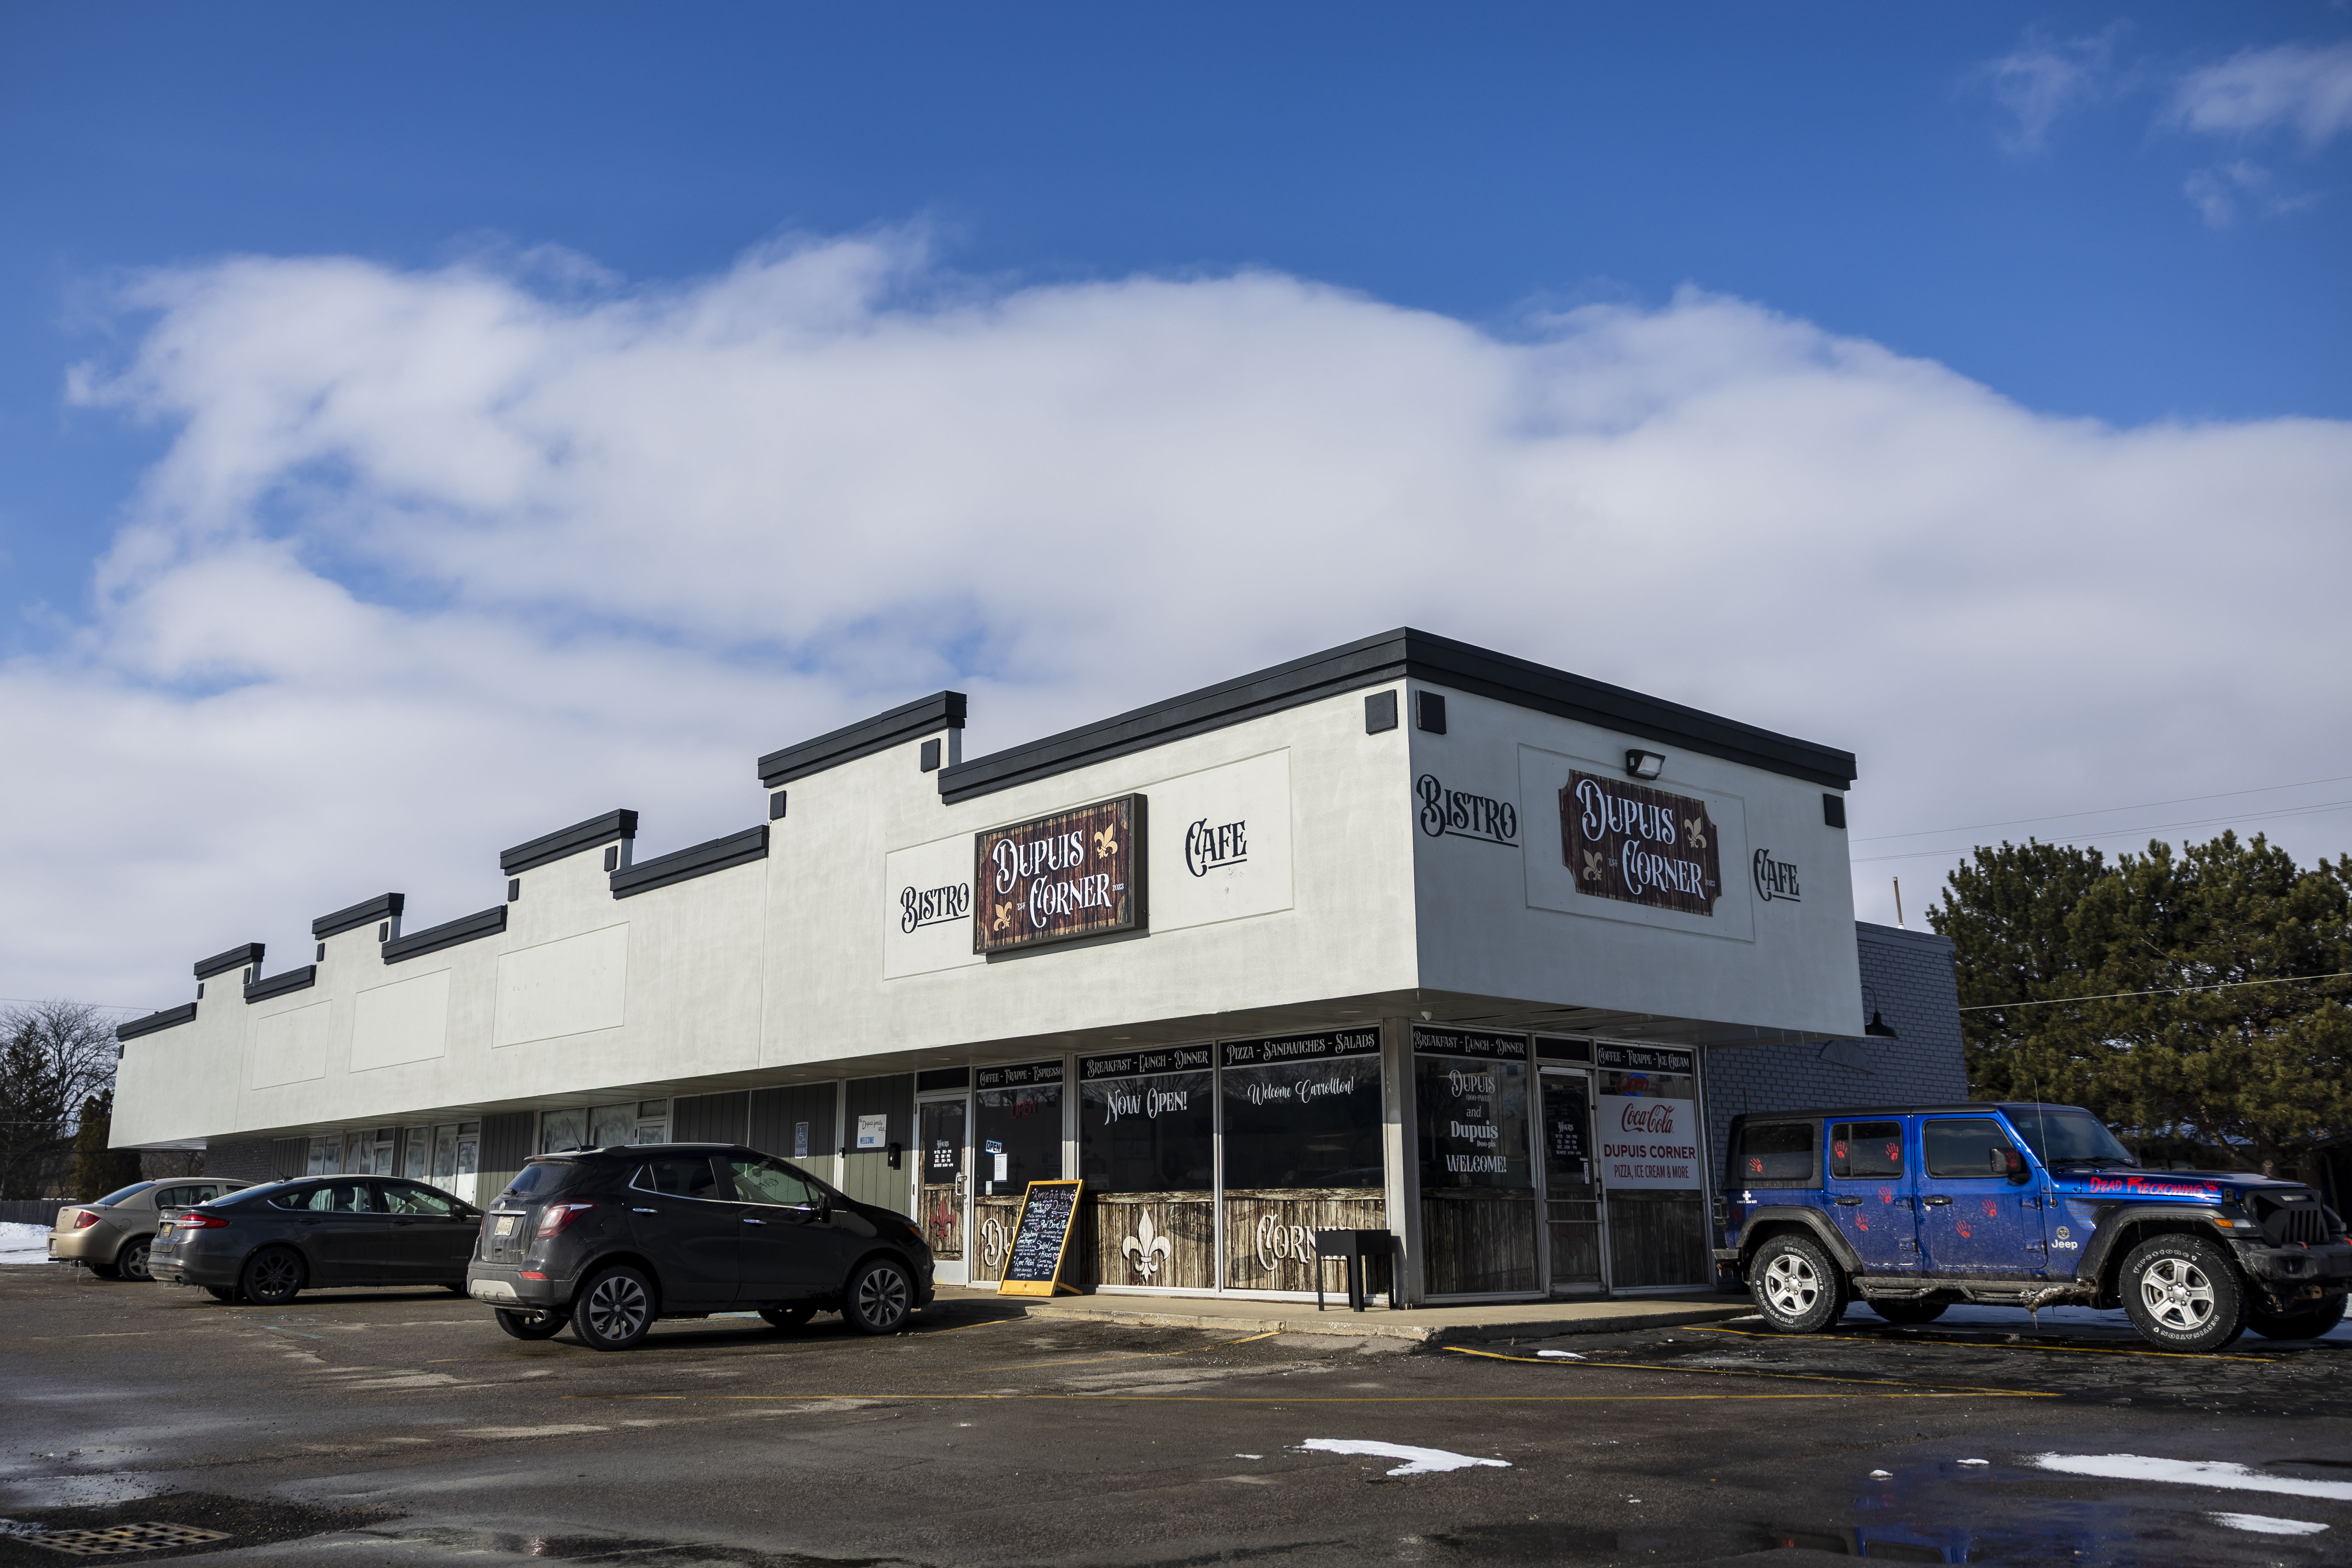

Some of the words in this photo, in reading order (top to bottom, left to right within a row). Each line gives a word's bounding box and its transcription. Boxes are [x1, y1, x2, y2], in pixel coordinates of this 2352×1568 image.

[1416, 774, 1517, 841] BISTRO
[1575, 779, 1675, 845] DUPUIS
[1185, 818, 1247, 877] CAFE
[992, 830, 1084, 895] DUPUIS
[1608, 858, 1618, 867] EST
[1622, 840, 1705, 900] CORNER
[1705, 879, 1715, 887] 2023
[1753, 848, 1799, 902] CAFE
[900, 882, 970, 933] BISTRO
[1017, 902, 1026, 911] EST
[1029, 873, 1112, 929] CORNER
[1112, 882, 1125, 892] 2023
[1227, 1045, 1254, 1065] PIZZA
[1264, 1038, 1325, 1060] SANDWICHES
[1335, 1034, 1375, 1054] SALADS
[1414, 1031, 1458, 1049] BREAKFAST
[1465, 1036, 1489, 1052] LUNCH
[1496, 1038, 1524, 1055] DINNER
[1087, 1058, 1131, 1078] BREAKFAST
[1139, 1054, 1166, 1072] LUNCH
[1174, 1050, 1208, 1069] DINNER
[1598, 1048, 1621, 1064] COFFEE
[1627, 1049, 1652, 1066] FRAPPE
[1656, 1052, 1667, 1068] ICE
[1668, 1054, 1689, 1069] CREAM
[980, 1071, 999, 1086] COFFEE
[1004, 1069, 1027, 1084] FRAPPE
[1033, 1066, 1063, 1080] ESPRESSO
[1449, 1070, 1495, 1097] DUPUIS
[1619, 1076, 1649, 1093] Open
[1248, 1082, 1291, 1105] Welcome
[1296, 1076, 1354, 1103] Carrollton!
[1012, 1098, 1036, 1119] OPEN
[1105, 1089, 1140, 1125] NOW
[1147, 1088, 1187, 1118] OPEN!
[1466, 1107, 1481, 1117] and
[874, 1120, 883, 1128] family
[1622, 1103, 1675, 1134] Coca-Cola
[1451, 1120, 1498, 1142] Dupuis
[987, 1142, 1001, 1152] OPEN
[1477, 1140, 1496, 1149] Doo-pis
[1604, 1144, 1646, 1158] DUPUIS
[1650, 1146, 1696, 1159] CORNER
[1446, 1155, 1507, 1173] WELCOME!
[1614, 1165, 1633, 1179] PIZZA,
[1634, 1165, 1644, 1178] ICE
[1645, 1165, 1666, 1178] CREAM
[1667, 1166, 1671, 1178] &
[1673, 1166, 1689, 1178] MORE
[1033, 1190, 1049, 1200] Love
[1060, 1189, 1070, 1200] the
[2090, 1177, 2122, 1193] DEAD
[1051, 1200, 1071, 1212] Drinks
[1040, 1220, 1049, 1230] Red
[1035, 1240, 1050, 1250] Salted
[2051, 1239, 2078, 1250] Jeep
[1785, 1247, 1823, 1284] DESTINATION
[2161, 1315, 2220, 1340] DESTINATION
